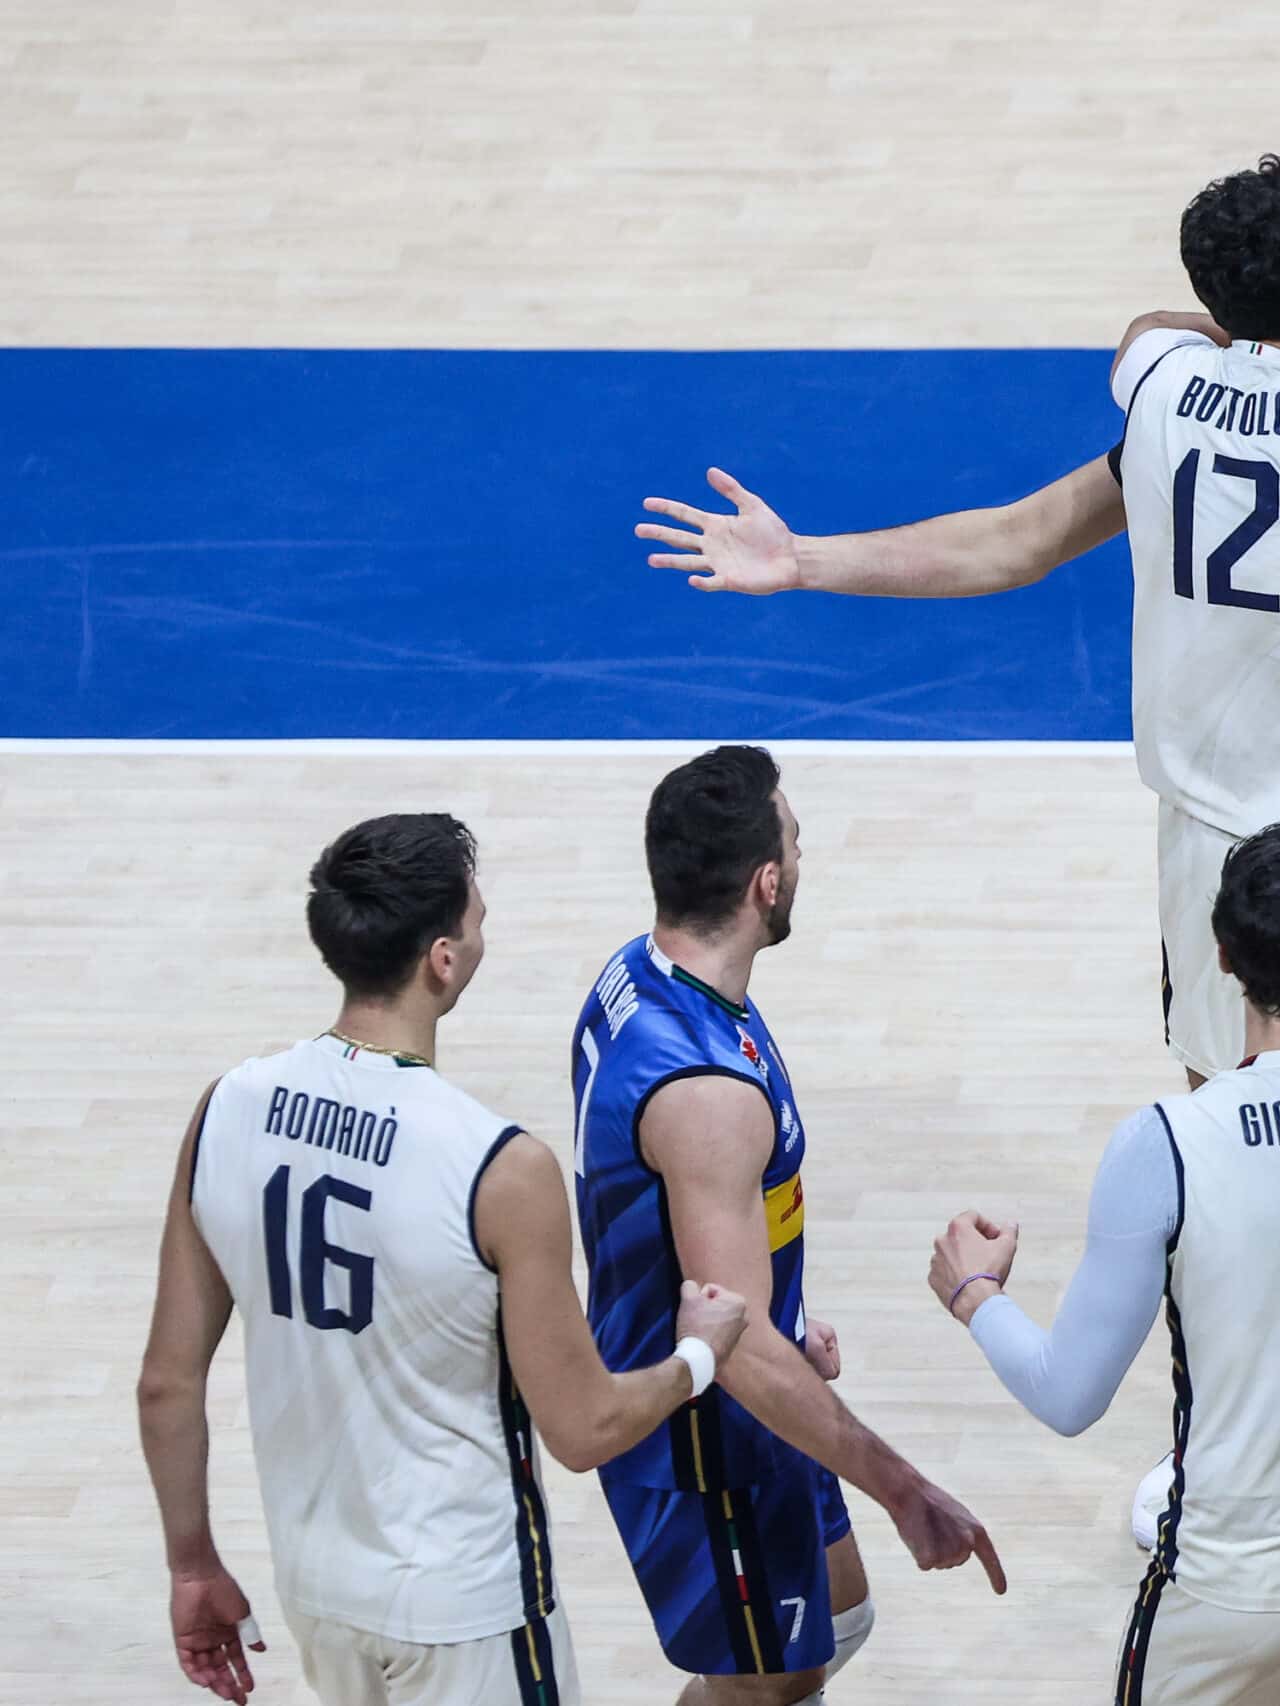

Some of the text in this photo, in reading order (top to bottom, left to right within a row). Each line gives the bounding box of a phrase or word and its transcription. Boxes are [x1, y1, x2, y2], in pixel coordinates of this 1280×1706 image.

[1173, 448, 1280, 613] 12
[265, 1086, 398, 1167] ROMANÒ
[263, 1164, 374, 1335] 16
[780, 1596, 806, 1643] 7
